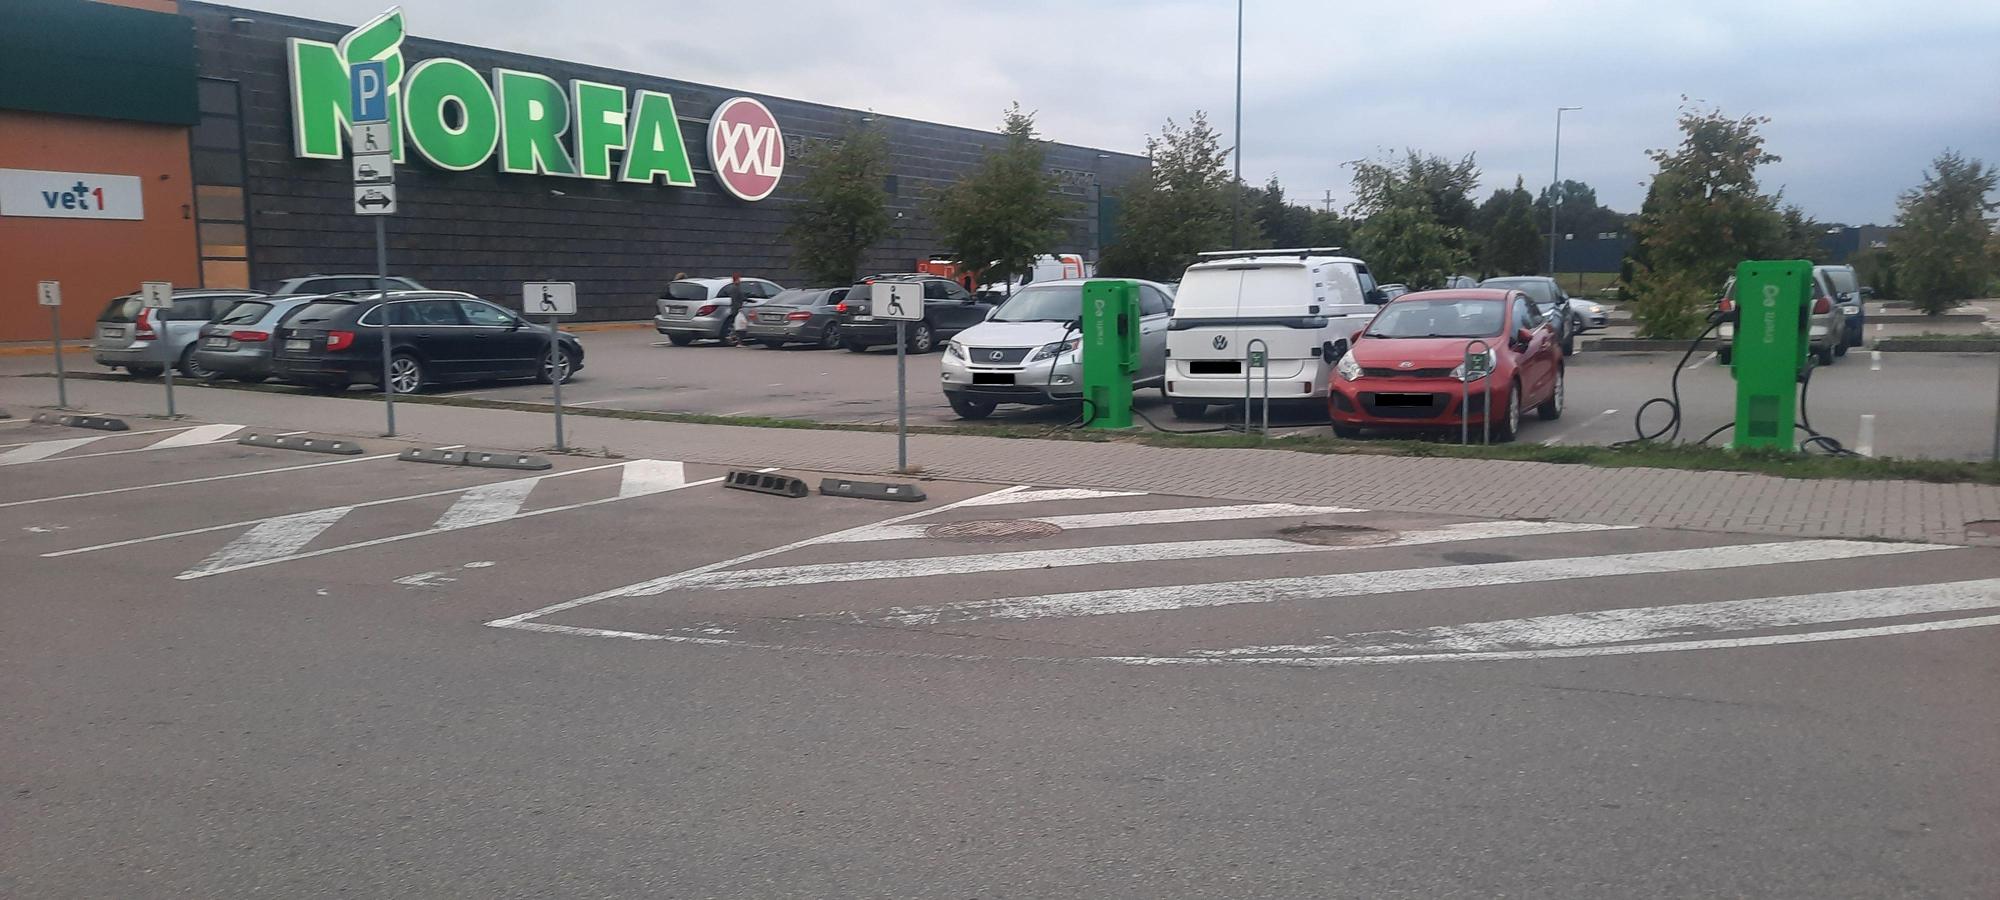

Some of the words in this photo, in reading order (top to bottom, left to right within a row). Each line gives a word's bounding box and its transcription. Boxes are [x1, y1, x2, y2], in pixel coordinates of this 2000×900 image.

[287, 6, 697, 187] NORFA
[719, 120, 781, 177] XXL
[359, 69, 379, 116] P
